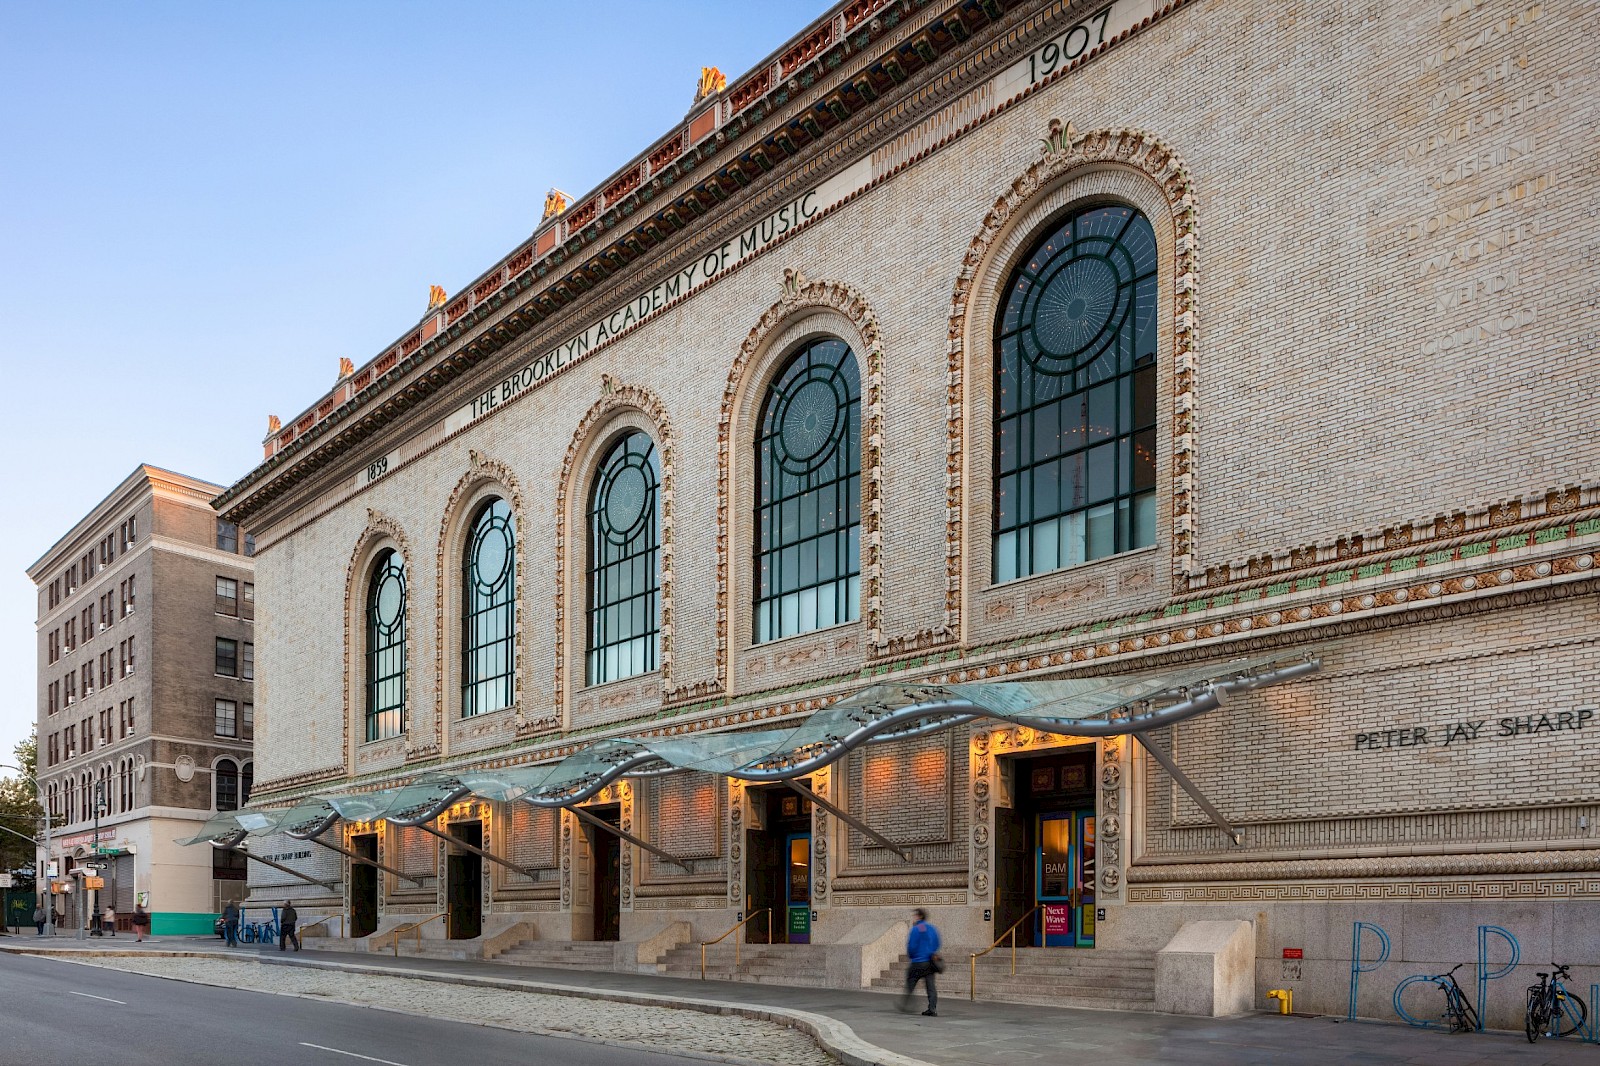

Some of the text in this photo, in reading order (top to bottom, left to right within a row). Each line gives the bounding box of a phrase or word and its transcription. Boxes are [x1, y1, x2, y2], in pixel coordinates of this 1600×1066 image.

[1029, 6, 1113, 84] 1907
[470, 190, 819, 419] THE BROOKLYN ACADEMY OF MUSIC
[366, 456, 389, 483] 1859
[1354, 709, 1594, 751] PETER JAY SHARP
[1045, 863, 1066, 874] BAM
[1046, 906, 1065, 915] Next
[1046, 916, 1066, 924] Wave
